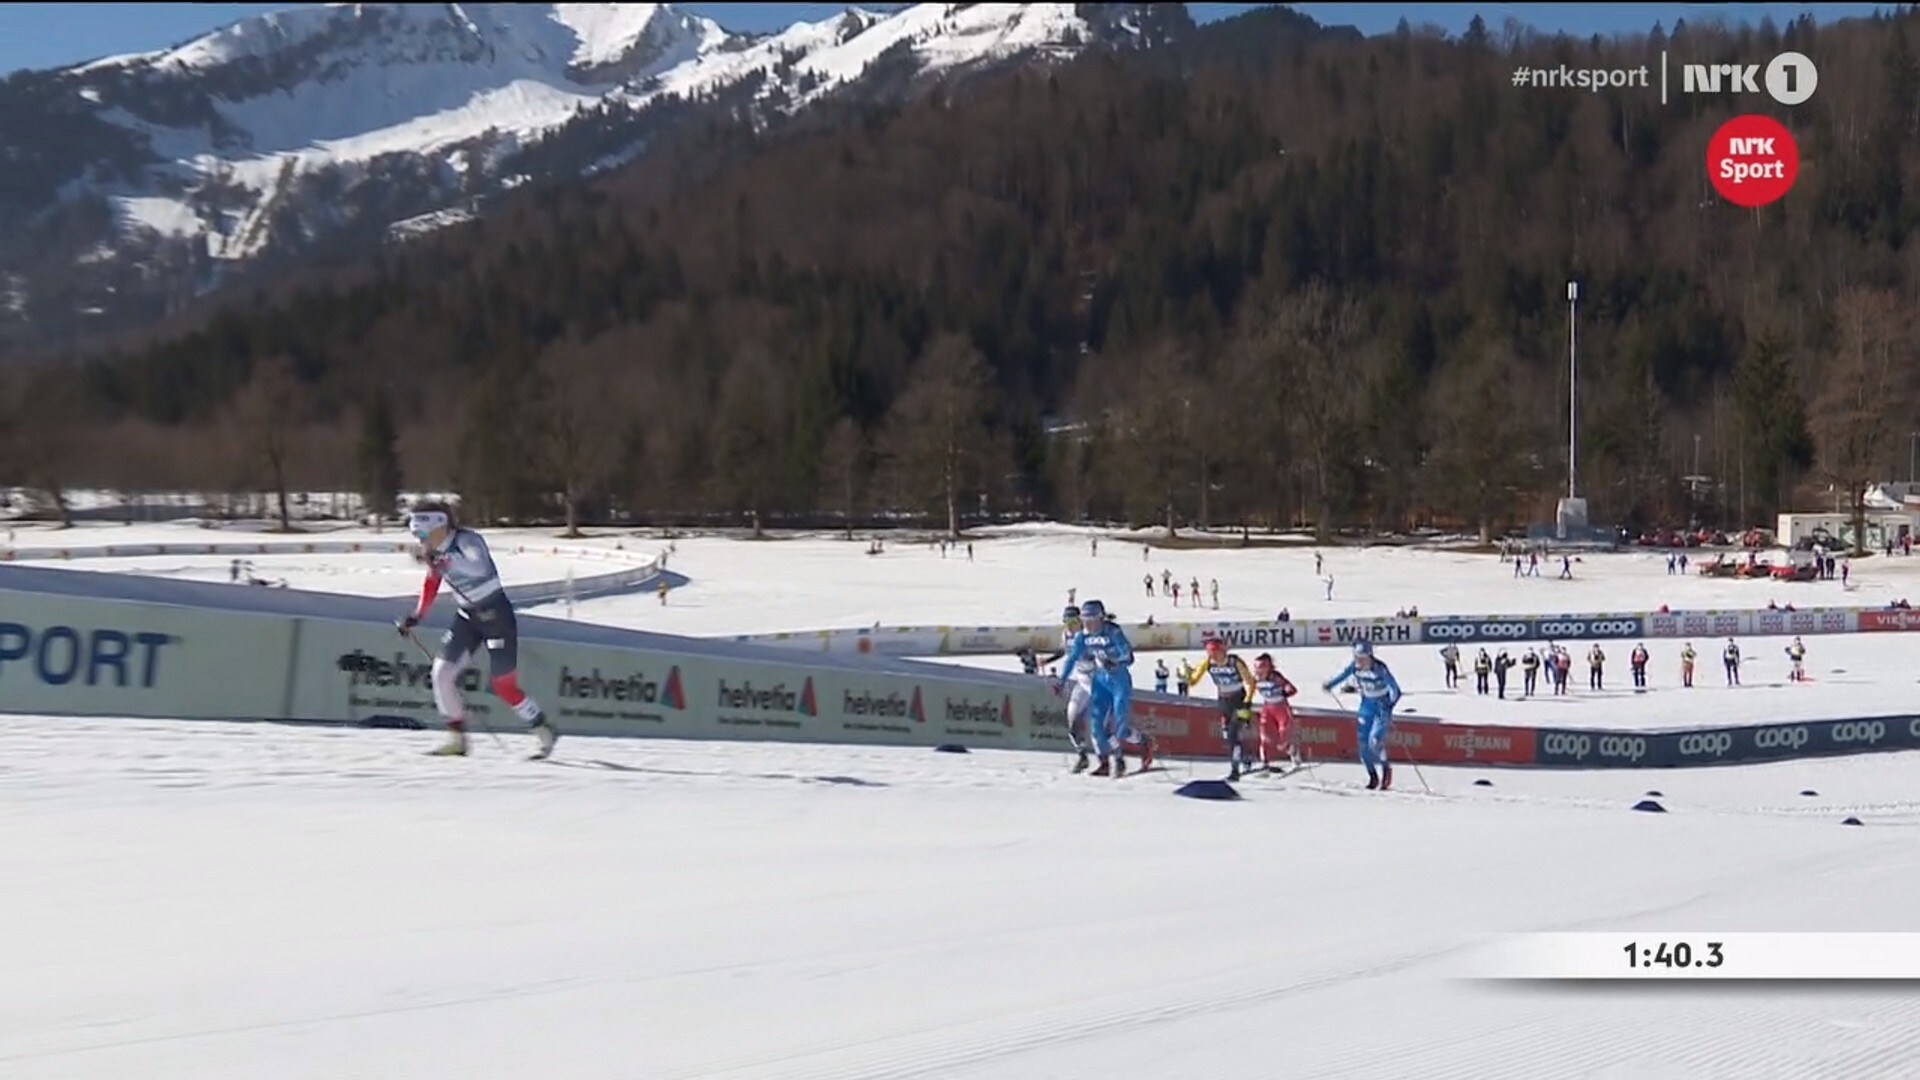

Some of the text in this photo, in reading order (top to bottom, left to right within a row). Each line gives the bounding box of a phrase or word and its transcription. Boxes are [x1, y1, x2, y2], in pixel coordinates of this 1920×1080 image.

[1428, 622, 1526, 639] coop coop
[1541, 619, 1637, 637] coop coop
[559, 666, 657, 704] helvetia
[718, 679, 796, 712] helvetia
[843, 688, 907, 717] helvetia
[1544, 733, 1646, 761] coop coop
[1679, 732, 1732, 757] coop
[1755, 725, 1808, 749] coop
[1832, 720, 1885, 744] coop
